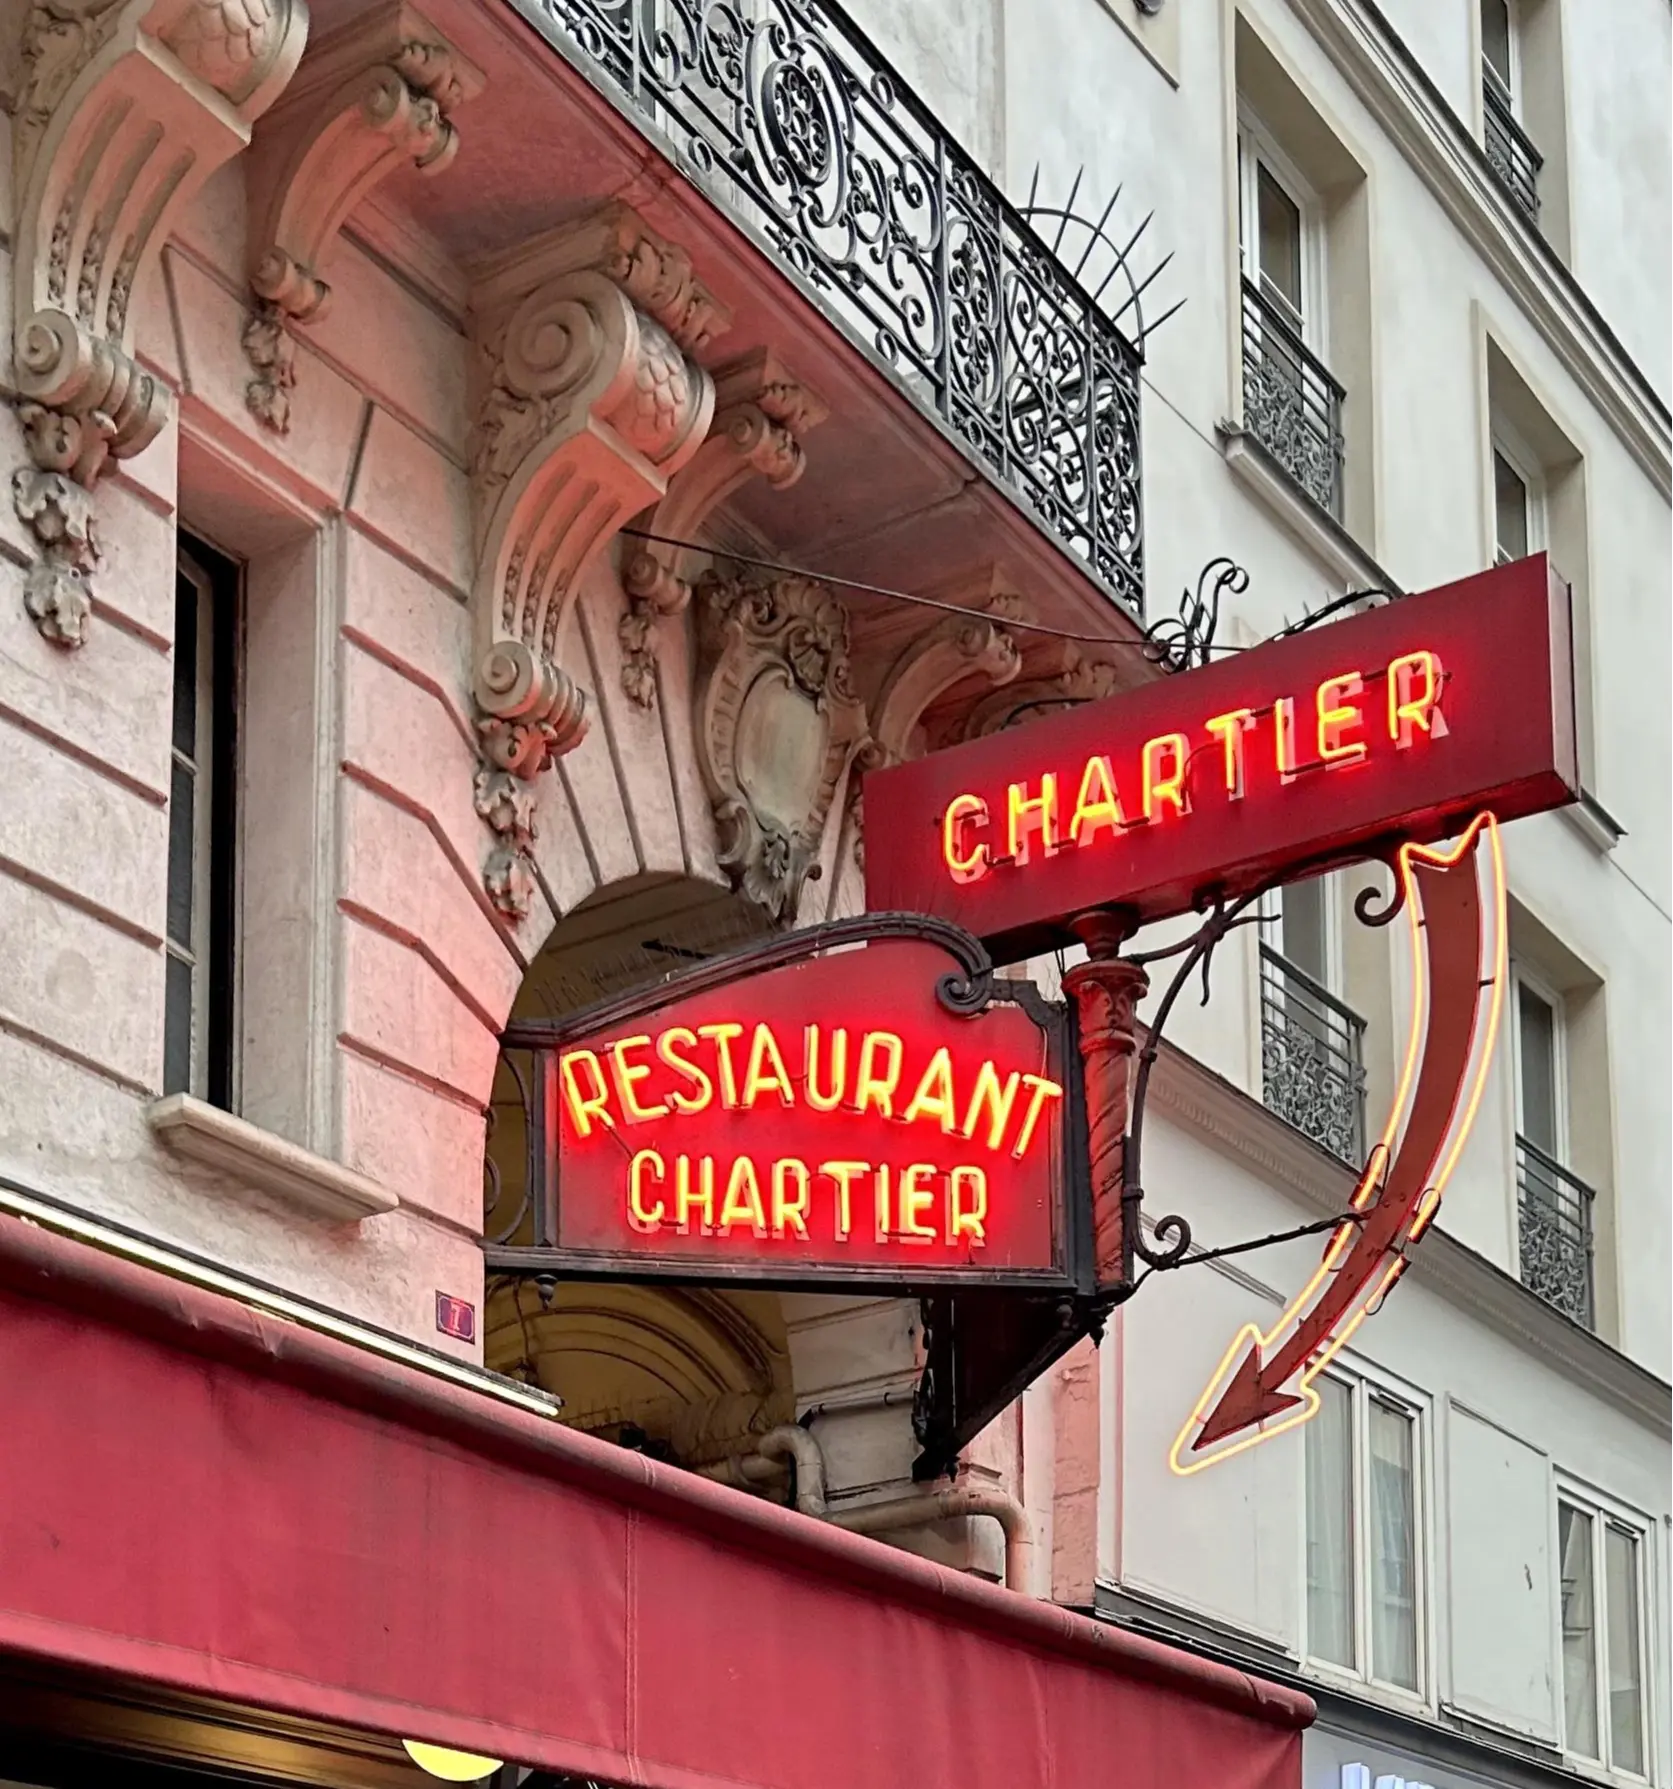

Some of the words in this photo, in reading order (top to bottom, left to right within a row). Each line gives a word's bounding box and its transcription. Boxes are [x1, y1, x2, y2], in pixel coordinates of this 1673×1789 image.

[944, 650, 1449, 884] CHARTIER
[560, 1022, 1064, 1159] RESTAURANT
[627, 1149, 987, 1247] CHARTIER
